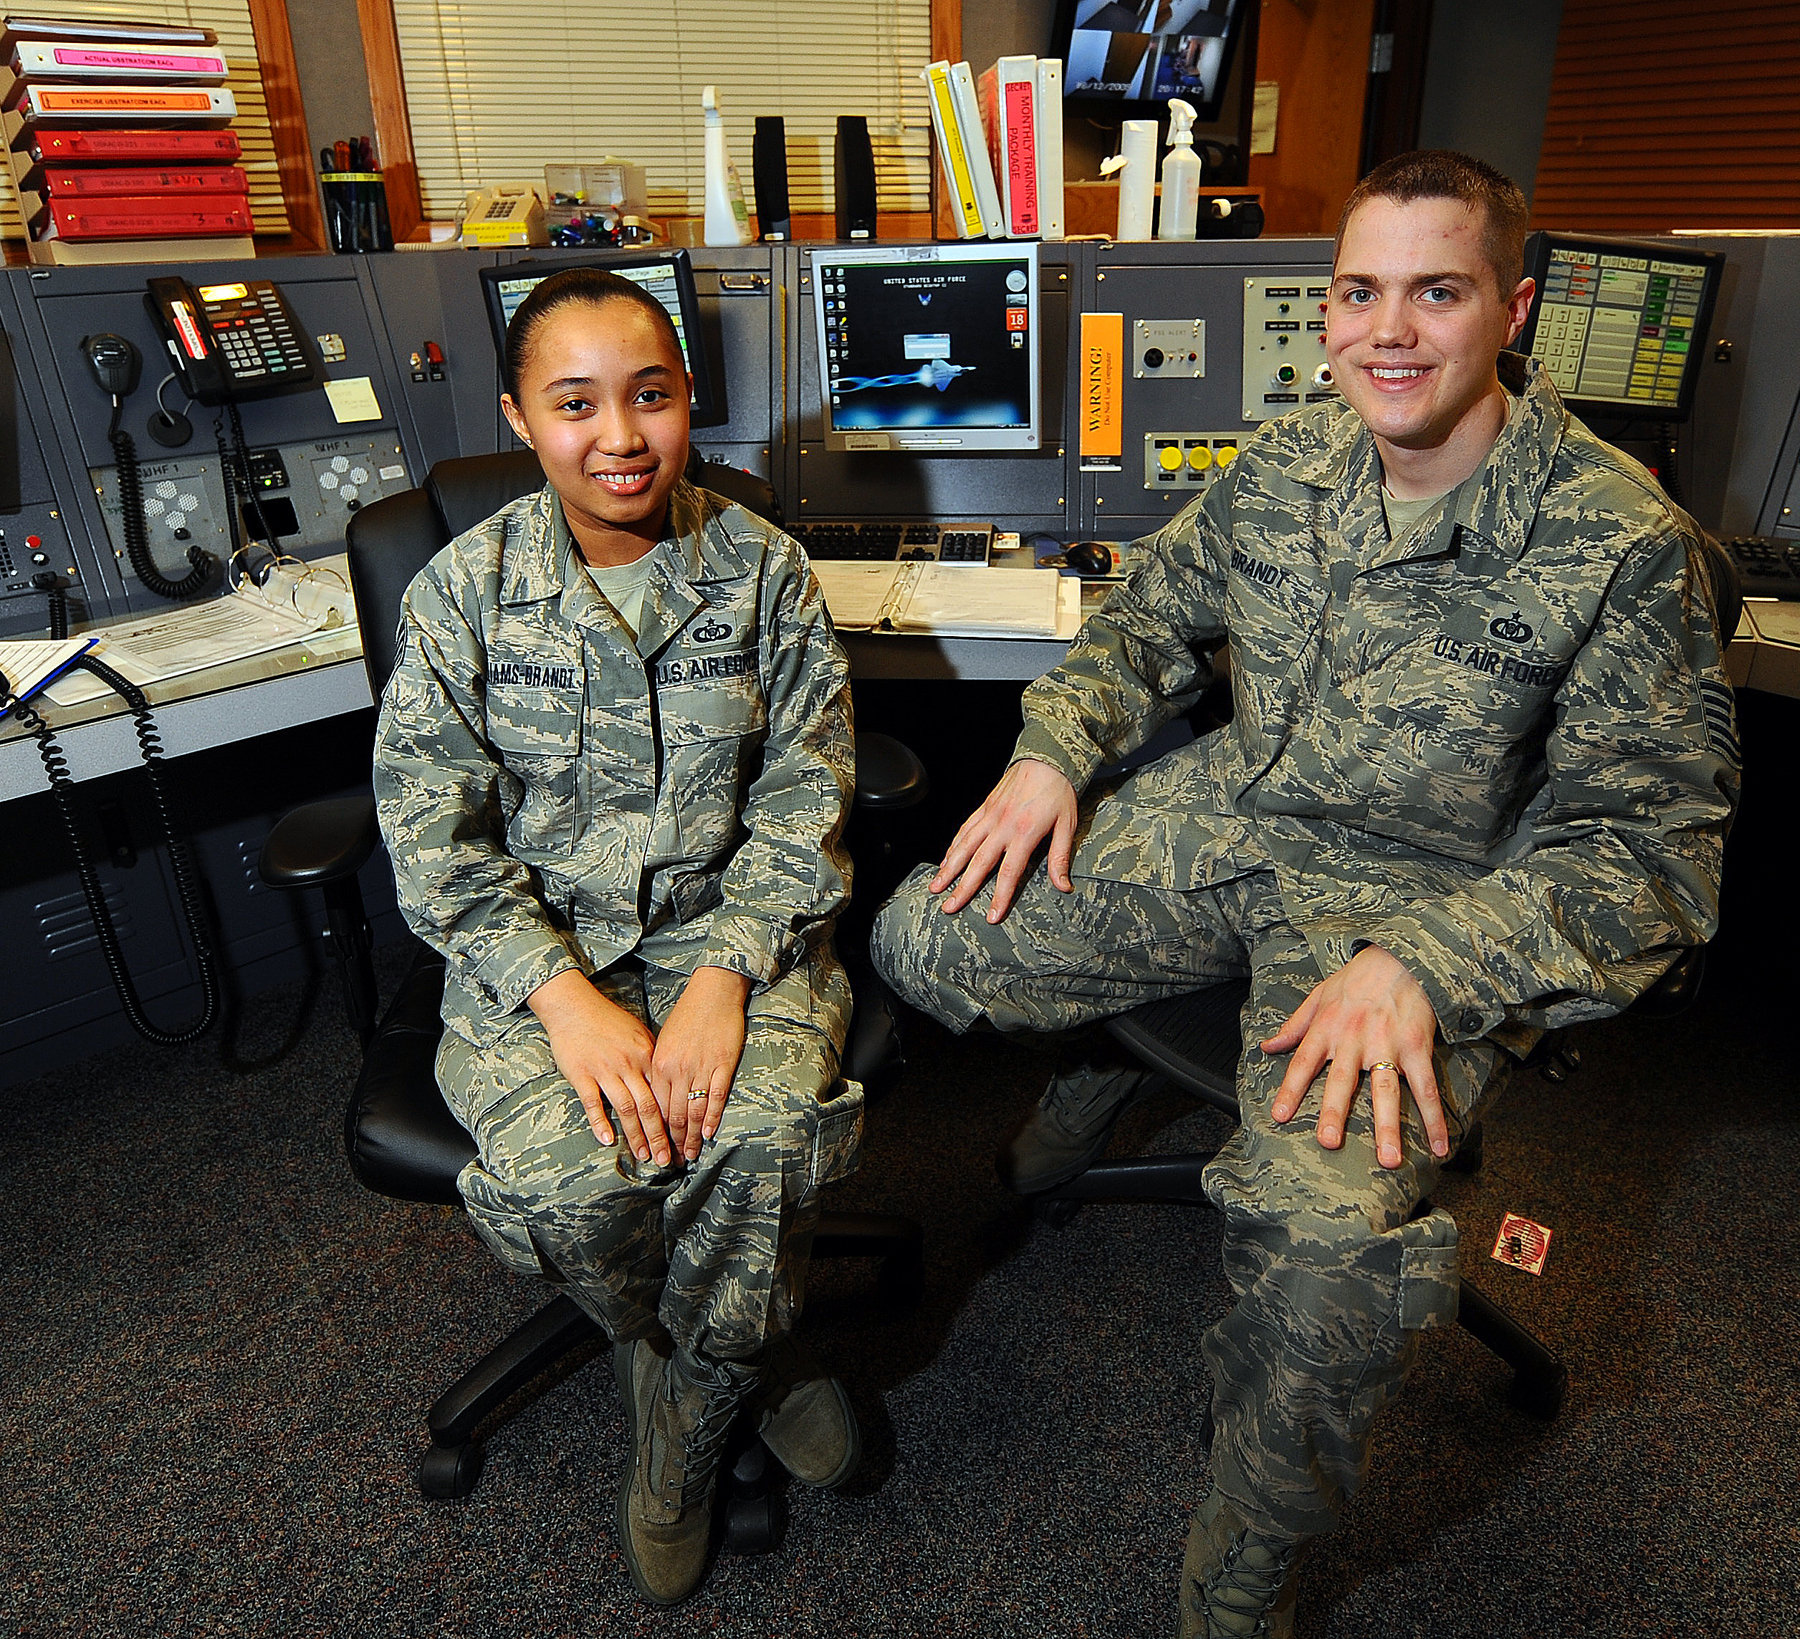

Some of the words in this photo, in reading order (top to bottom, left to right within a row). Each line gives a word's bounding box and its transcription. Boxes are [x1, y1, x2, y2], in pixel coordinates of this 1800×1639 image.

[84, 55, 110, 63] ACTUAL
[1007, 82, 1030, 92] SECRET
[1021, 95, 1033, 152] MONTHLY
[1009, 127, 1020, 180] PACKAGE
[1024, 155, 1036, 209] TRAINING
[1013, 224, 1038, 234] SECRET
[947, 275, 966, 283] FORCE
[1010, 314, 1024, 326] 18
[1105, 351, 1113, 386] Computer
[1089, 346, 1103, 432] WARNING!
[1104, 415, 1111, 426] Do
[1230, 549, 1290, 589] BRANDT
[657, 661, 687, 685] U.S.
[690, 656, 721, 680] AIR
[723, 651, 759, 675] FORC
[1433, 634, 1462, 663] U.S.
[1464, 646, 1500, 676] AIR
